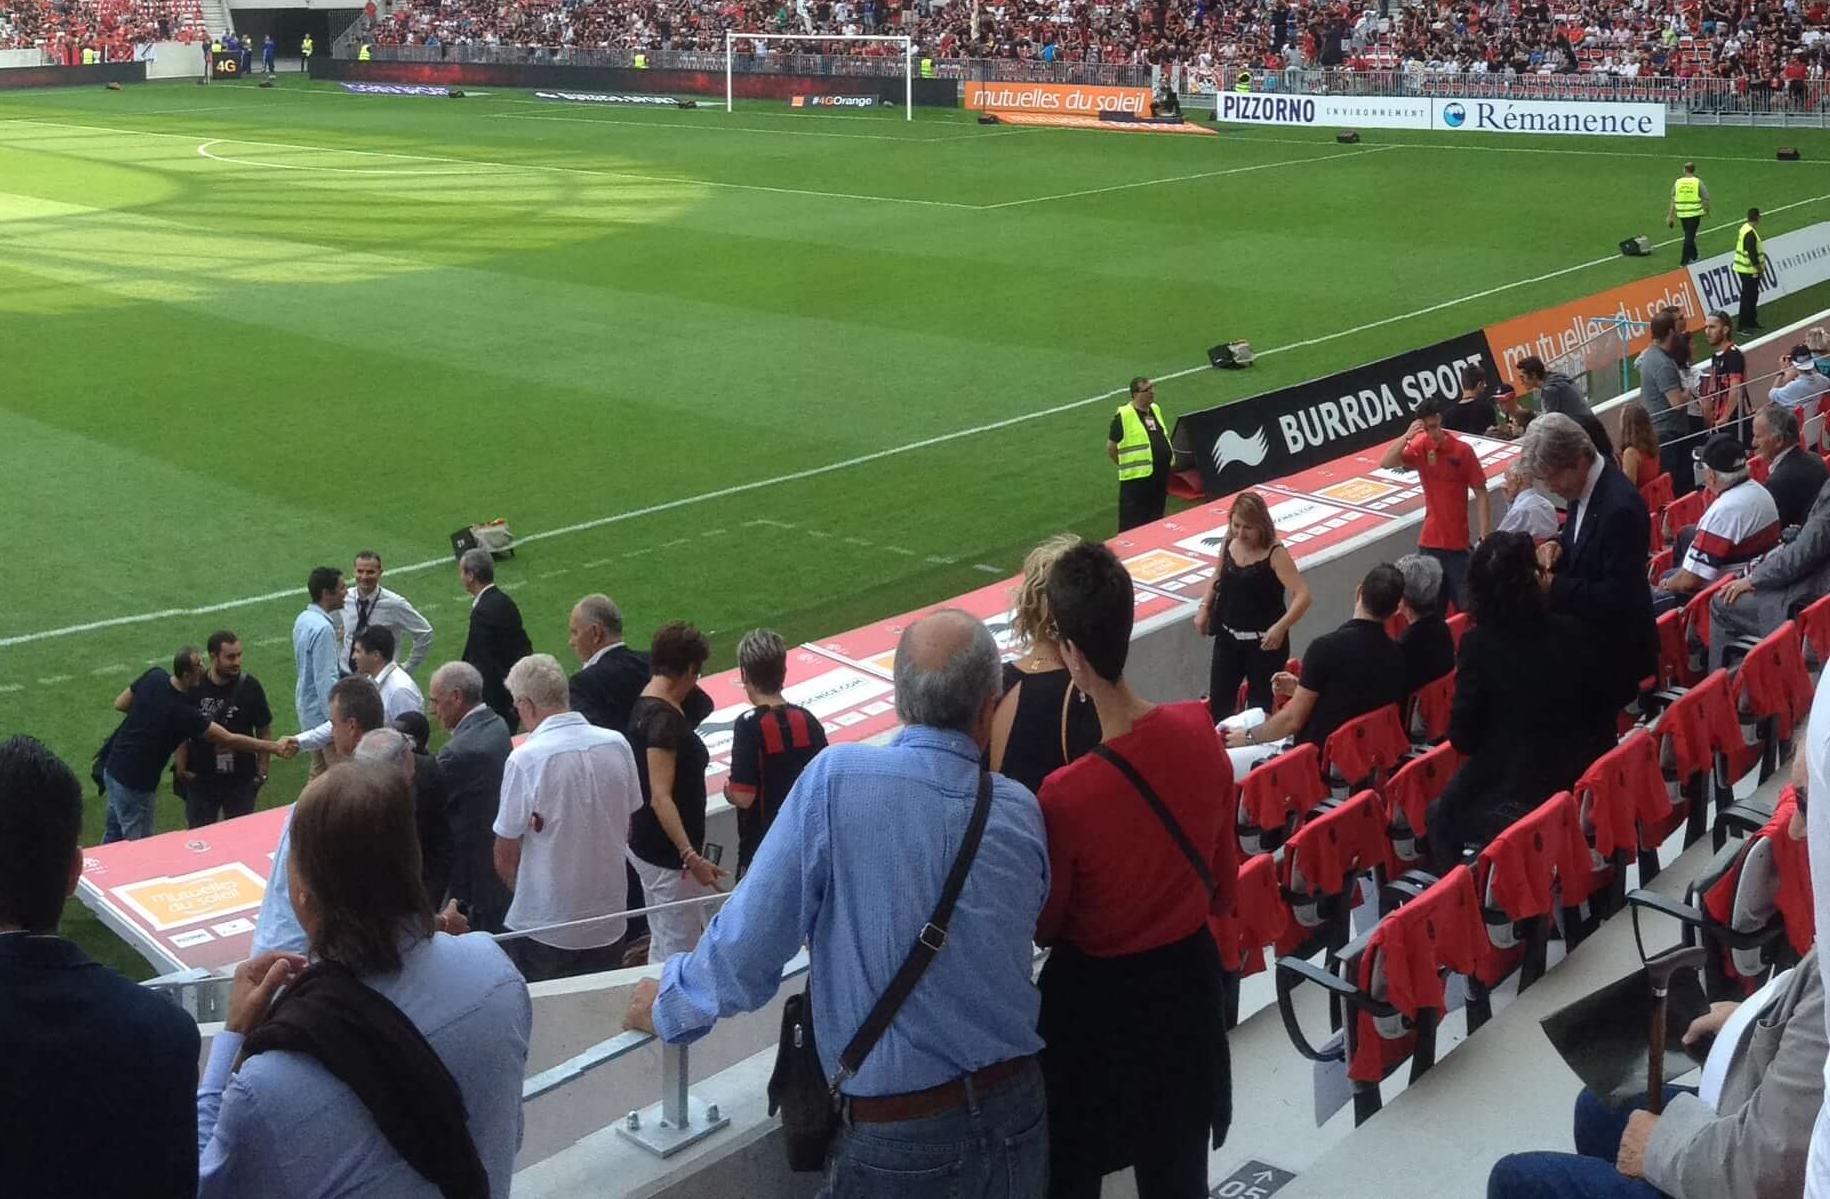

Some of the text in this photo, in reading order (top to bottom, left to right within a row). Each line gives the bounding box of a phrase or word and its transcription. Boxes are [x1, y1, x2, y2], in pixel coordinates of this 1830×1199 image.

[216, 59, 237, 73] 4G
[973, 87, 1146, 114] mutuelles du soleil
[1223, 96, 1316, 123] PIZZORNO
[1326, 105, 1425, 119] ENVIRONNEMENT
[1476, 103, 1653, 135] Rémanence
[1278, 383, 1403, 456] BURRDA
